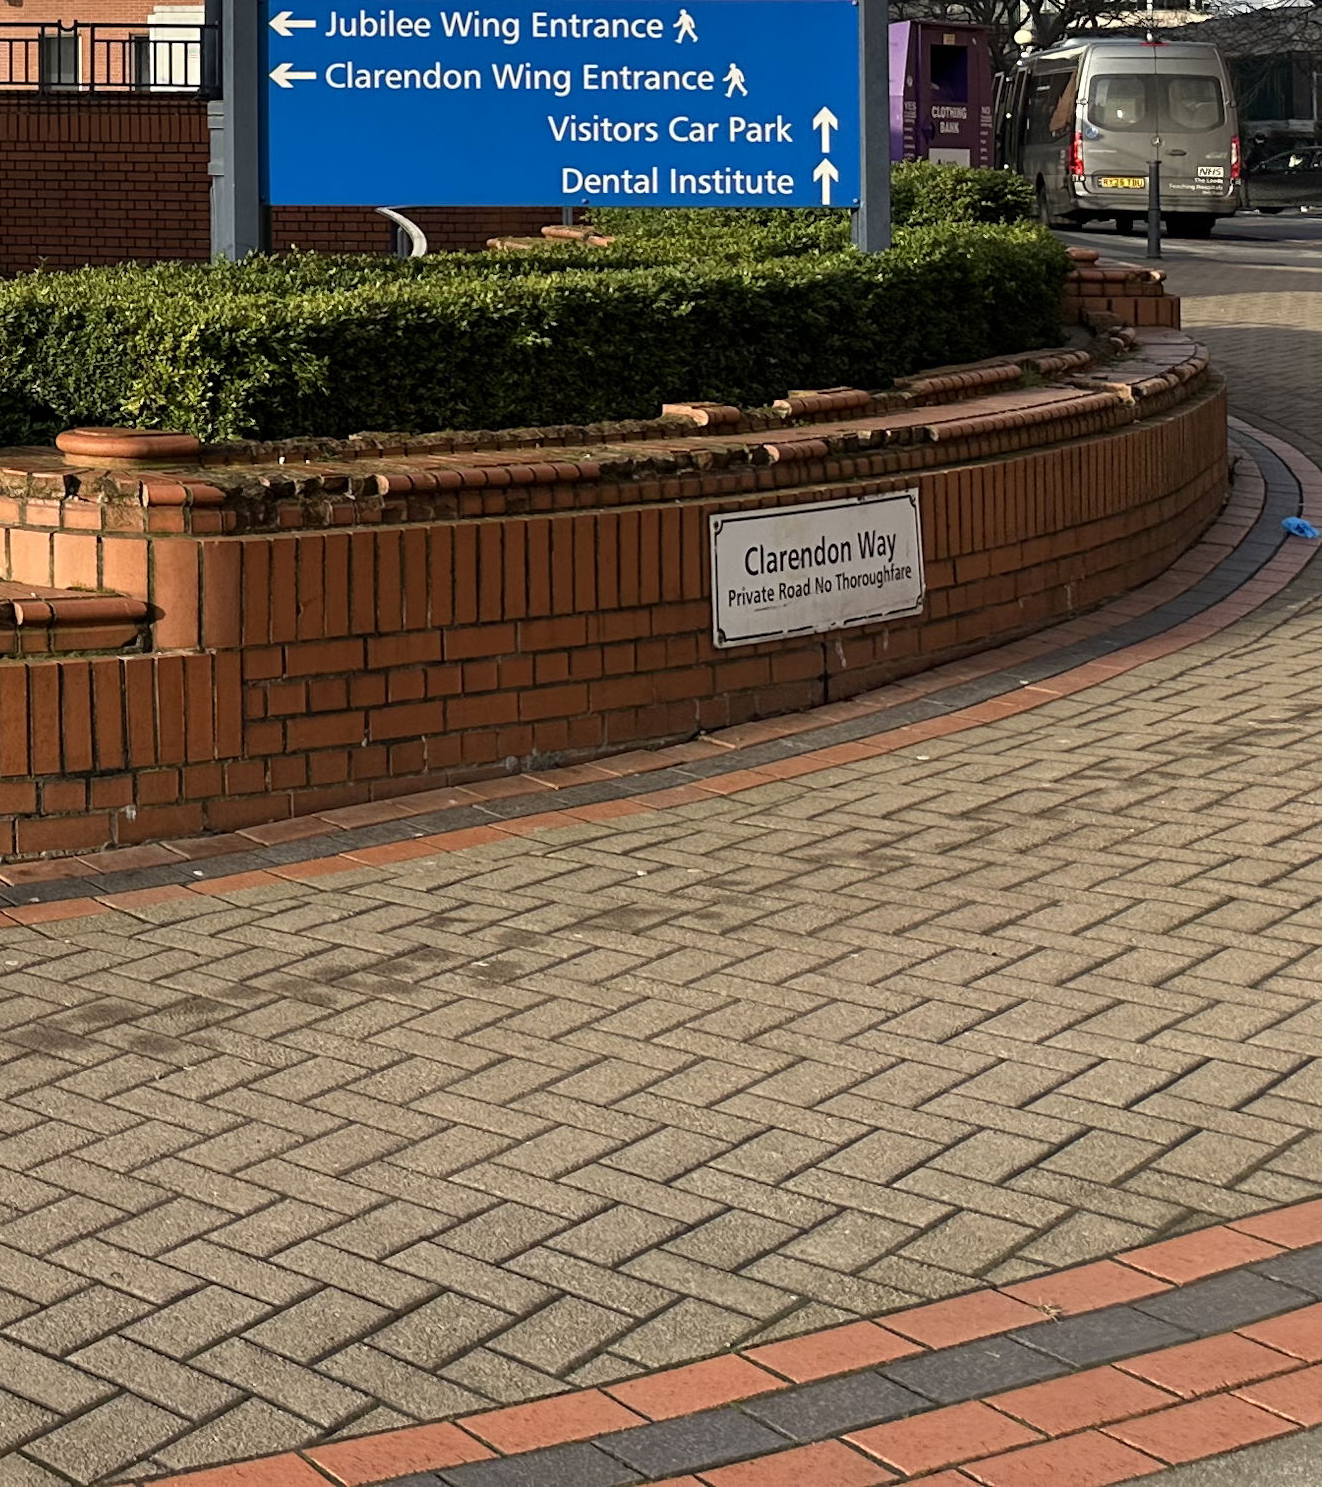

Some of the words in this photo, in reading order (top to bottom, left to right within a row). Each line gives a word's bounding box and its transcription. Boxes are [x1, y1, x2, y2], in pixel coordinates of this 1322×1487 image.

[325, 10, 431, 38] Jubilee
[441, 10, 520, 45] Wing
[532, 11, 663, 39] Entrance
[325, 61, 481, 90] Clarendon
[492, 62, 571, 97] Wing
[583, 63, 714, 91] Entrance
[931, 105, 967, 120] CLOTHING
[939, 121, 960, 133] BANK
[547, 114, 658, 142] Visitors
[669, 115, 719, 143] Car
[729, 114, 793, 143] Park
[562, 166, 658, 194] Dental
[670, 167, 794, 195] Institute
[1198, 167, 1223, 176] NHS
[744, 535, 852, 576] Clarendon
[858, 529, 897, 563] Way
[728, 586, 775, 608] Private
[779, 577, 810, 601] Road
[815, 577, 832, 594] No
[836, 563, 913, 590] Thoroughfare
